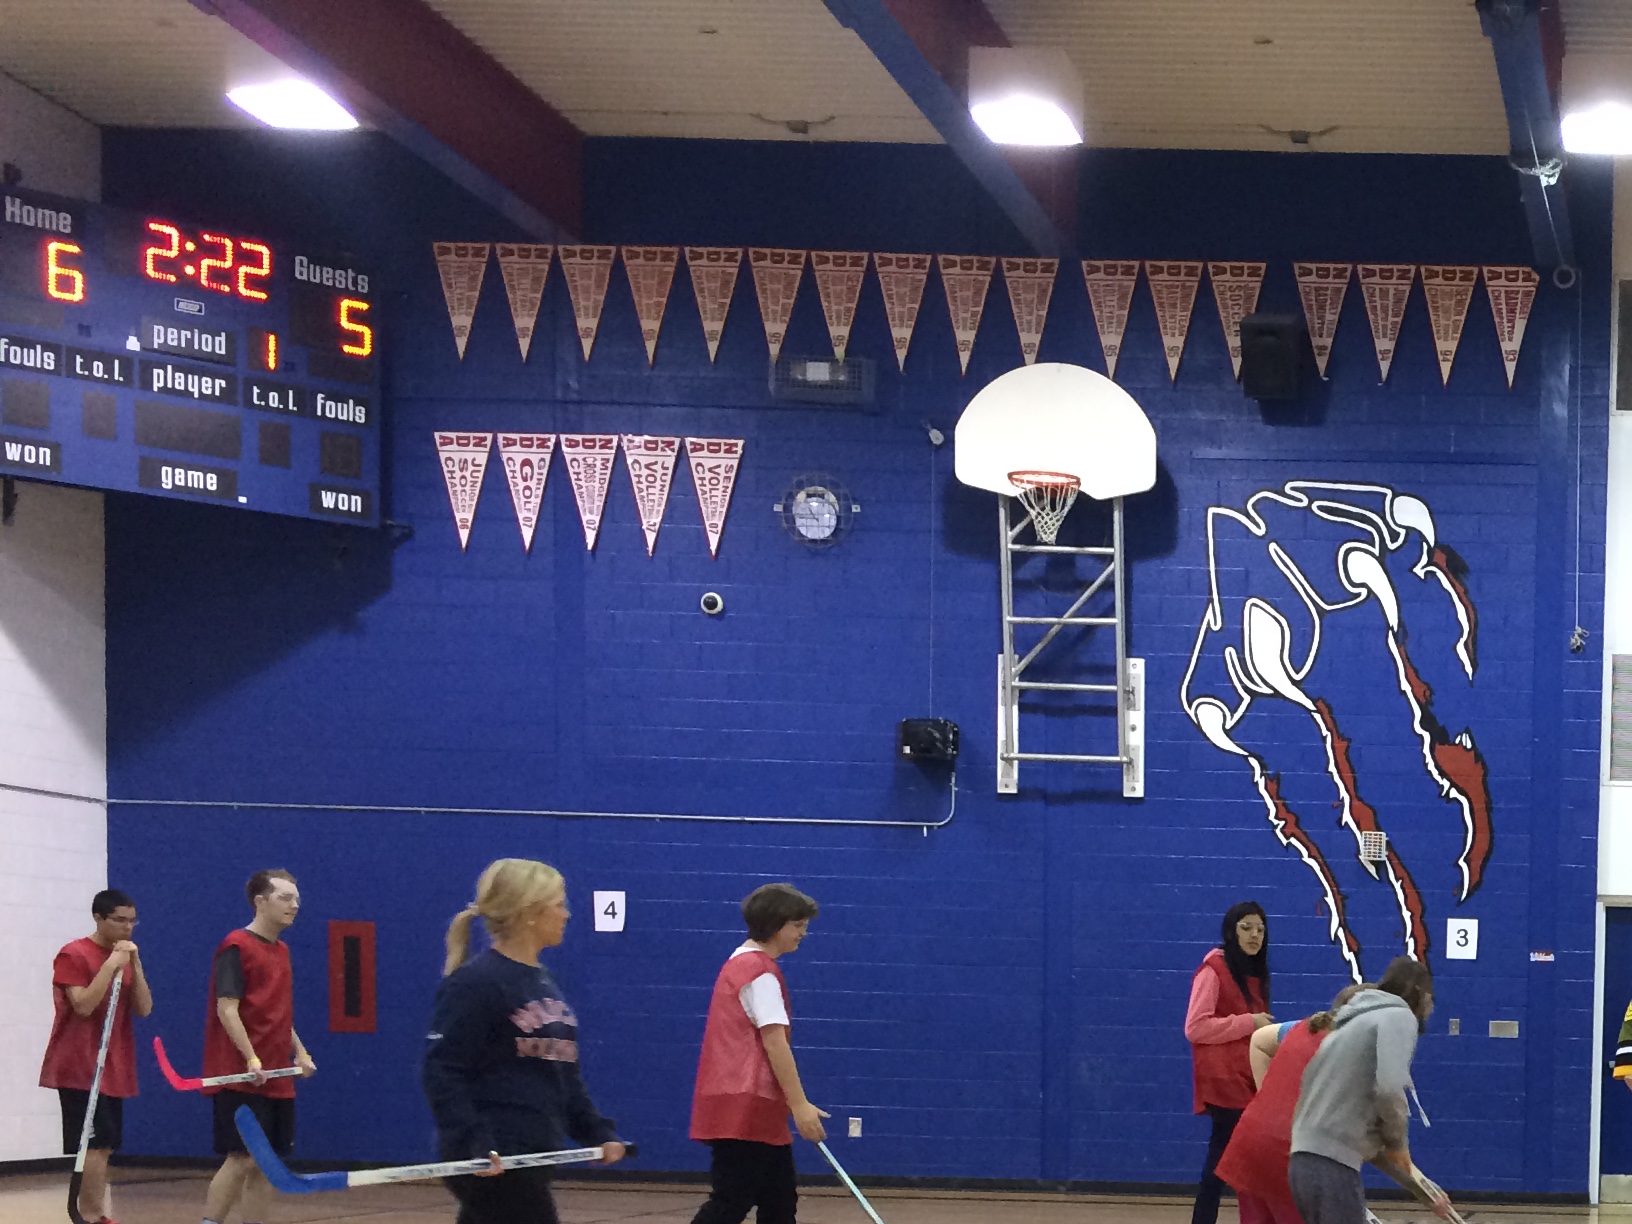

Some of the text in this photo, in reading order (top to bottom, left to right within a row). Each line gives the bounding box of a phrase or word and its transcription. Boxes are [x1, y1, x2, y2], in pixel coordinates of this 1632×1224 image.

[4, 196, 72, 234] Home
[47, 240, 84, 302] 6
[146, 222, 271, 300] 2:22
[294, 255, 369, 294] Guests
[1102, 284, 1115, 335] VOLLEYBALL
[1166, 284, 1179, 337] BADMINTON
[1315, 286, 1329, 338] BADMINTON
[1366, 286, 1380, 339] CHAMPIONS
[1389, 287, 1406, 341] JUNIOR BOYS
[1427, 287, 1442, 341] CHAMPIONS
[1454, 288, 1469, 316] SENIOR
[1491, 289, 1506, 342] CHAMPIONS
[1504, 290, 1520, 342] BADMINTON
[1518, 290, 1534, 320] MIDGET
[153, 324, 227, 355] period
[339, 298, 373, 357] 5
[1178, 314, 1188, 336] TEAM
[0, 338, 55, 371] fouls
[267, 333, 276, 370] 1
[833, 334, 845, 347] 95
[895, 336, 907, 349] 95
[958, 339, 971, 352] 95
[1024, 342, 1036, 355] 95
[1104, 344, 1117, 357] 95
[1167, 345, 1180, 358] 95
[1440, 350, 1452, 362] 94
[1505, 350, 1517, 362] 93
[152, 365, 227, 398] player
[316, 393, 366, 424] fouls
[5, 441, 51, 466] won
[439, 435, 487, 448] NDA
[503, 436, 550, 449] NDA
[565, 437, 613, 450] NDA
[690, 441, 738, 454] NDA
[161, 465, 218, 491] game
[468, 457, 482, 502] JUNIOR
[534, 457, 546, 499] GIRLS
[582, 457, 597, 483] CROSS
[597, 457, 610, 503] MIDGET
[657, 461, 669, 507] JUNIOR
[459, 458, 468, 513] SOCCER
[520, 458, 534, 514] GOLF
[720, 464, 734, 508] SENIOR
[321, 490, 362, 513] won
[459, 518, 469, 529] 06
[522, 516, 533, 528] 07
[586, 519, 596, 531] 07
[709, 522, 719, 534] 07
[603, 901, 617, 919] 4
[1456, 929, 1468, 947] 3
